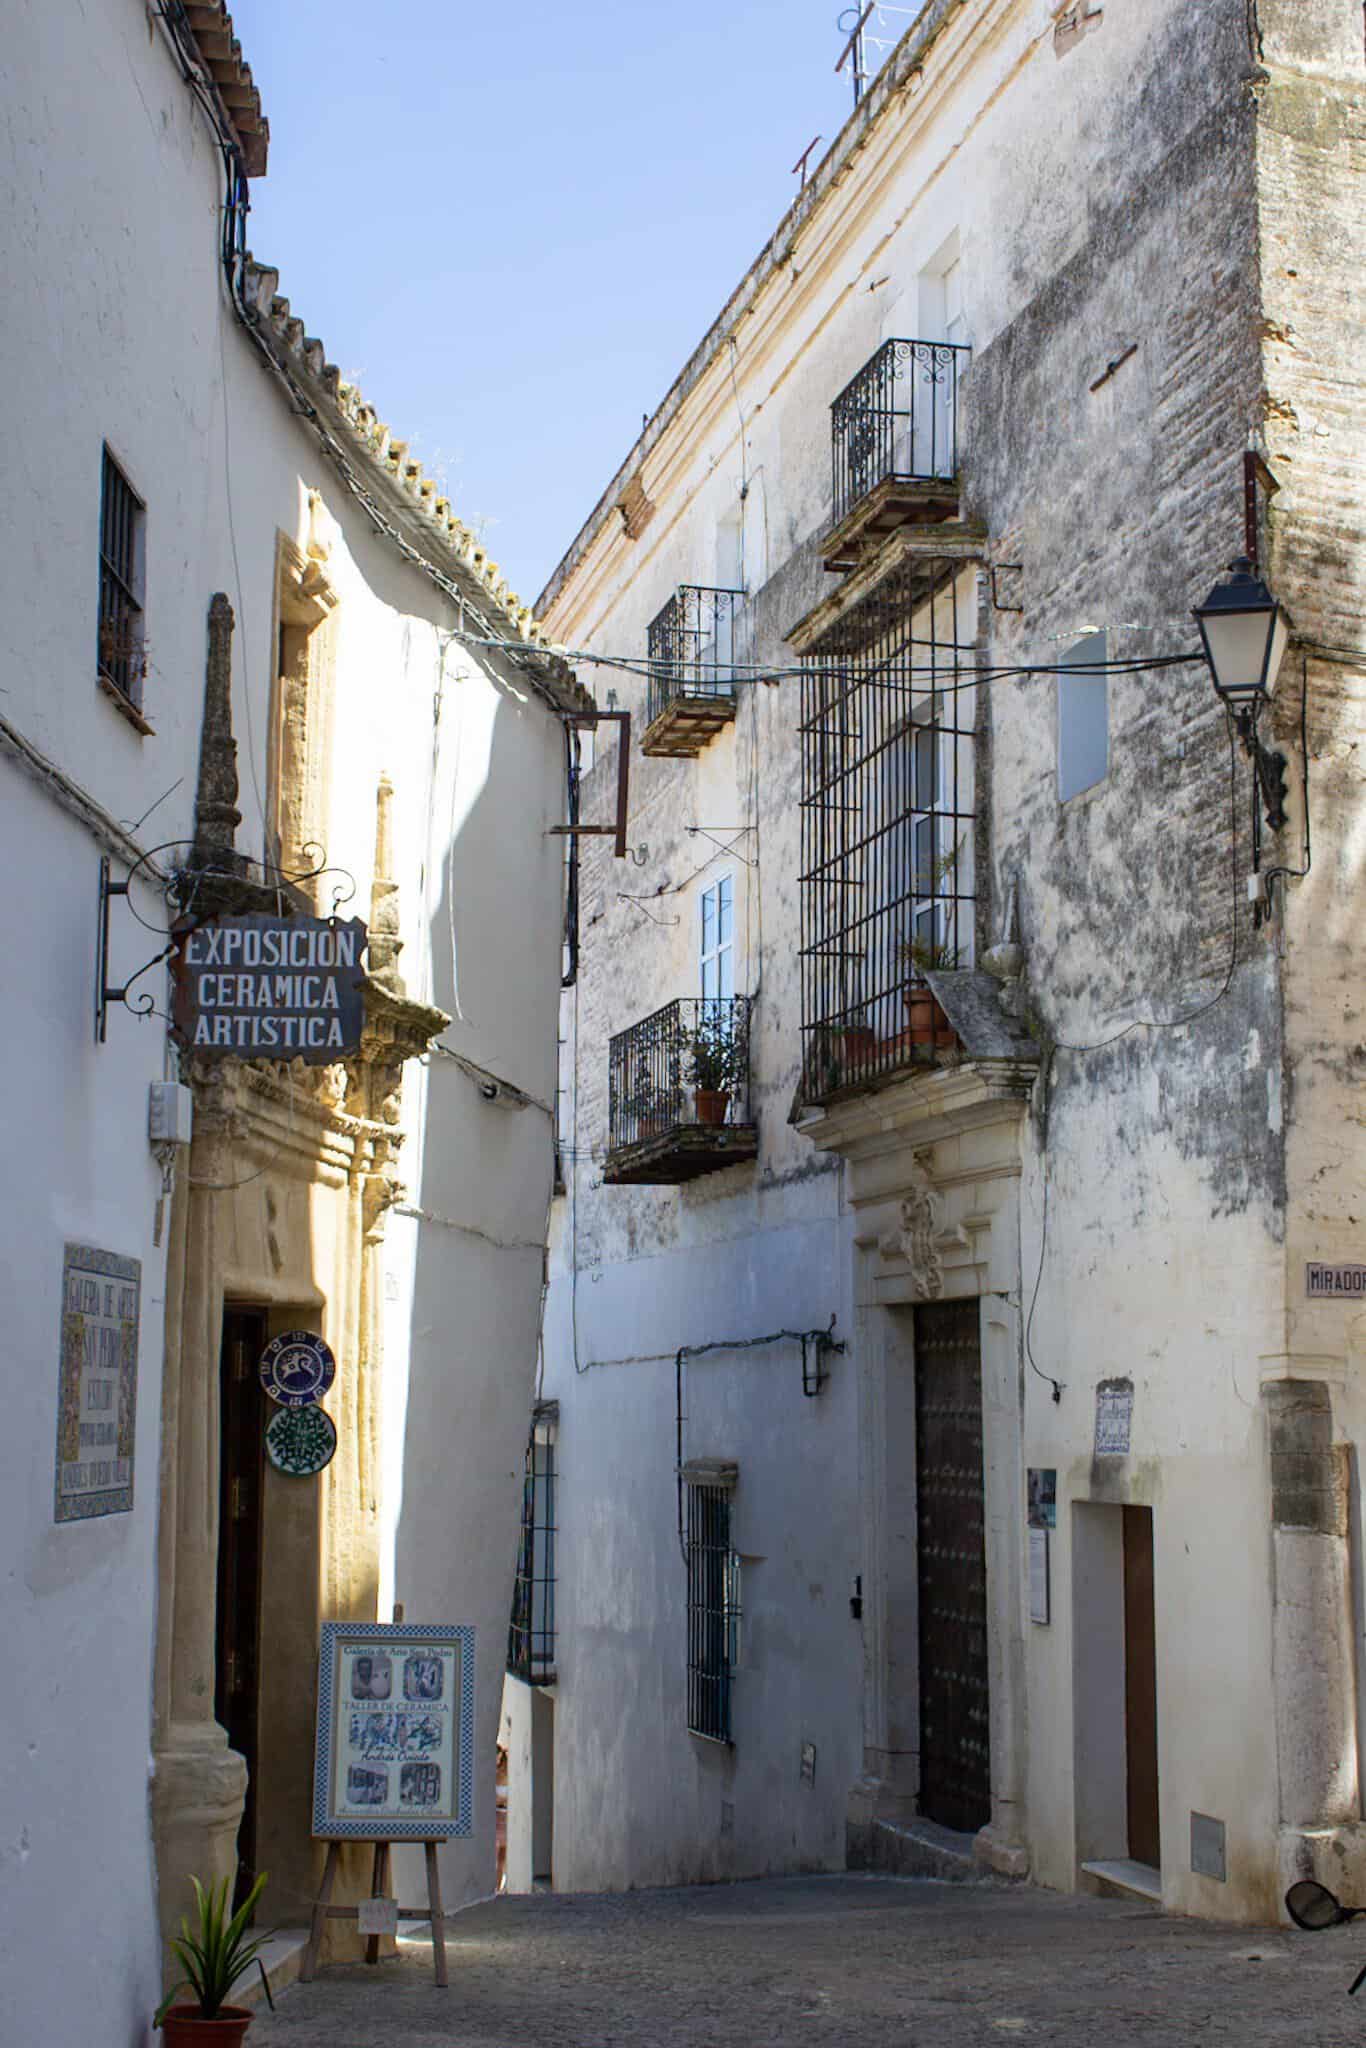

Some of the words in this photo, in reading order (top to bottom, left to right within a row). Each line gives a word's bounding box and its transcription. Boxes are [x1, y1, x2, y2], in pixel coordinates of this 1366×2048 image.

[184, 928, 355, 967] EXPOSICION
[198, 974, 340, 1009] CERAMICA
[193, 1014, 344, 1048] ARTISTICA
